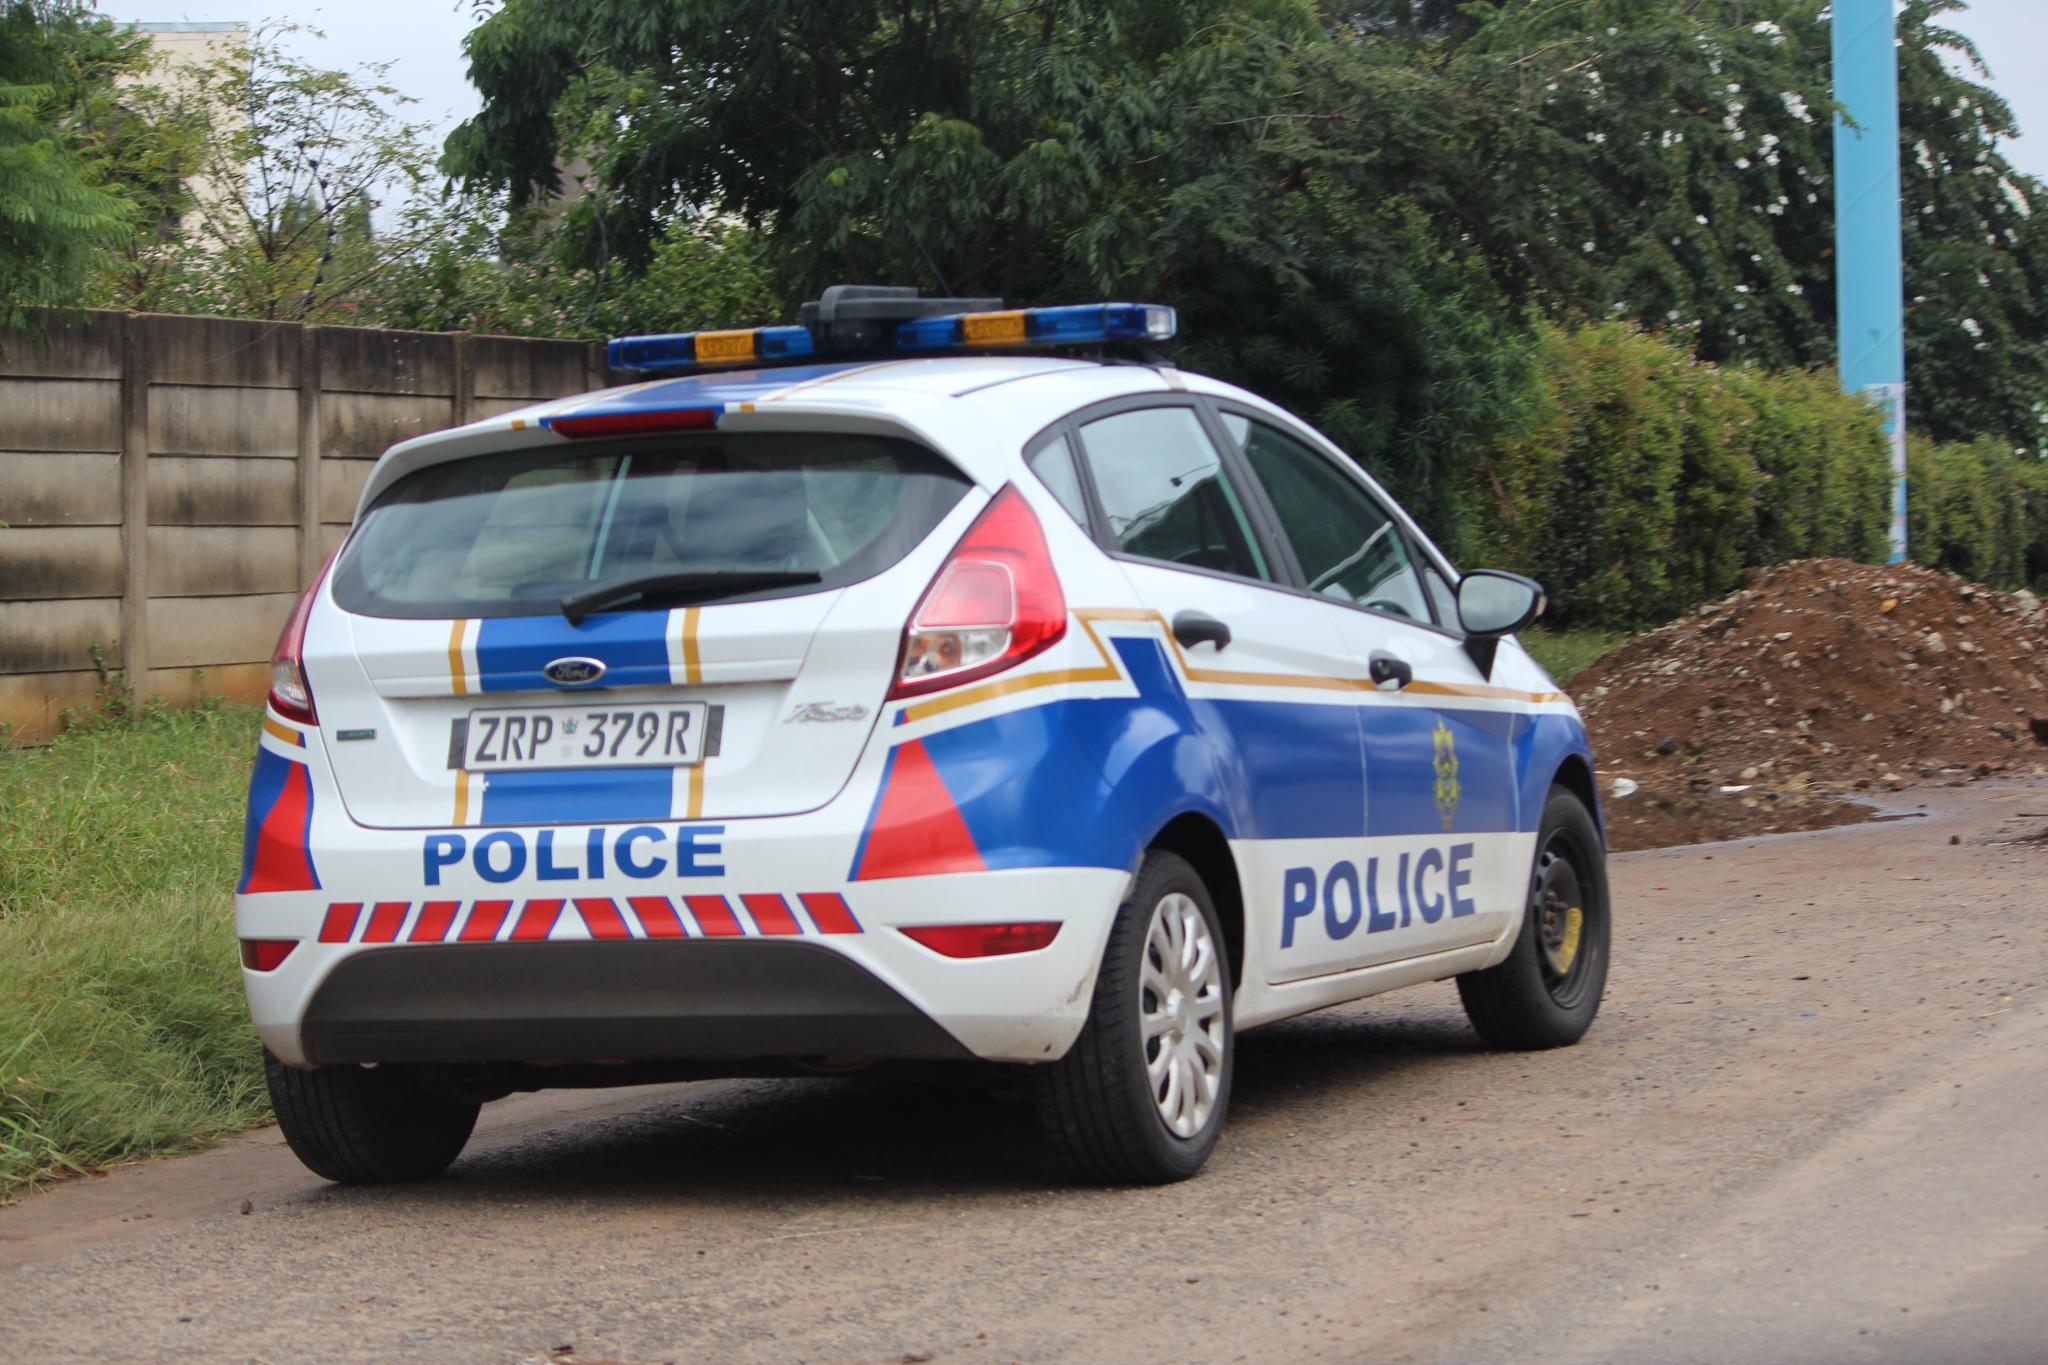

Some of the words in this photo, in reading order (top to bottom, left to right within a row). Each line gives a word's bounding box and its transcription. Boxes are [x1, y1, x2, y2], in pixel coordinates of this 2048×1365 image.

[554, 663, 592, 680] Ford
[474, 716, 554, 763] ZRP
[583, 710, 692, 758] 379R
[424, 825, 726, 886] POLICE
[1280, 842, 1476, 949] POLICE
